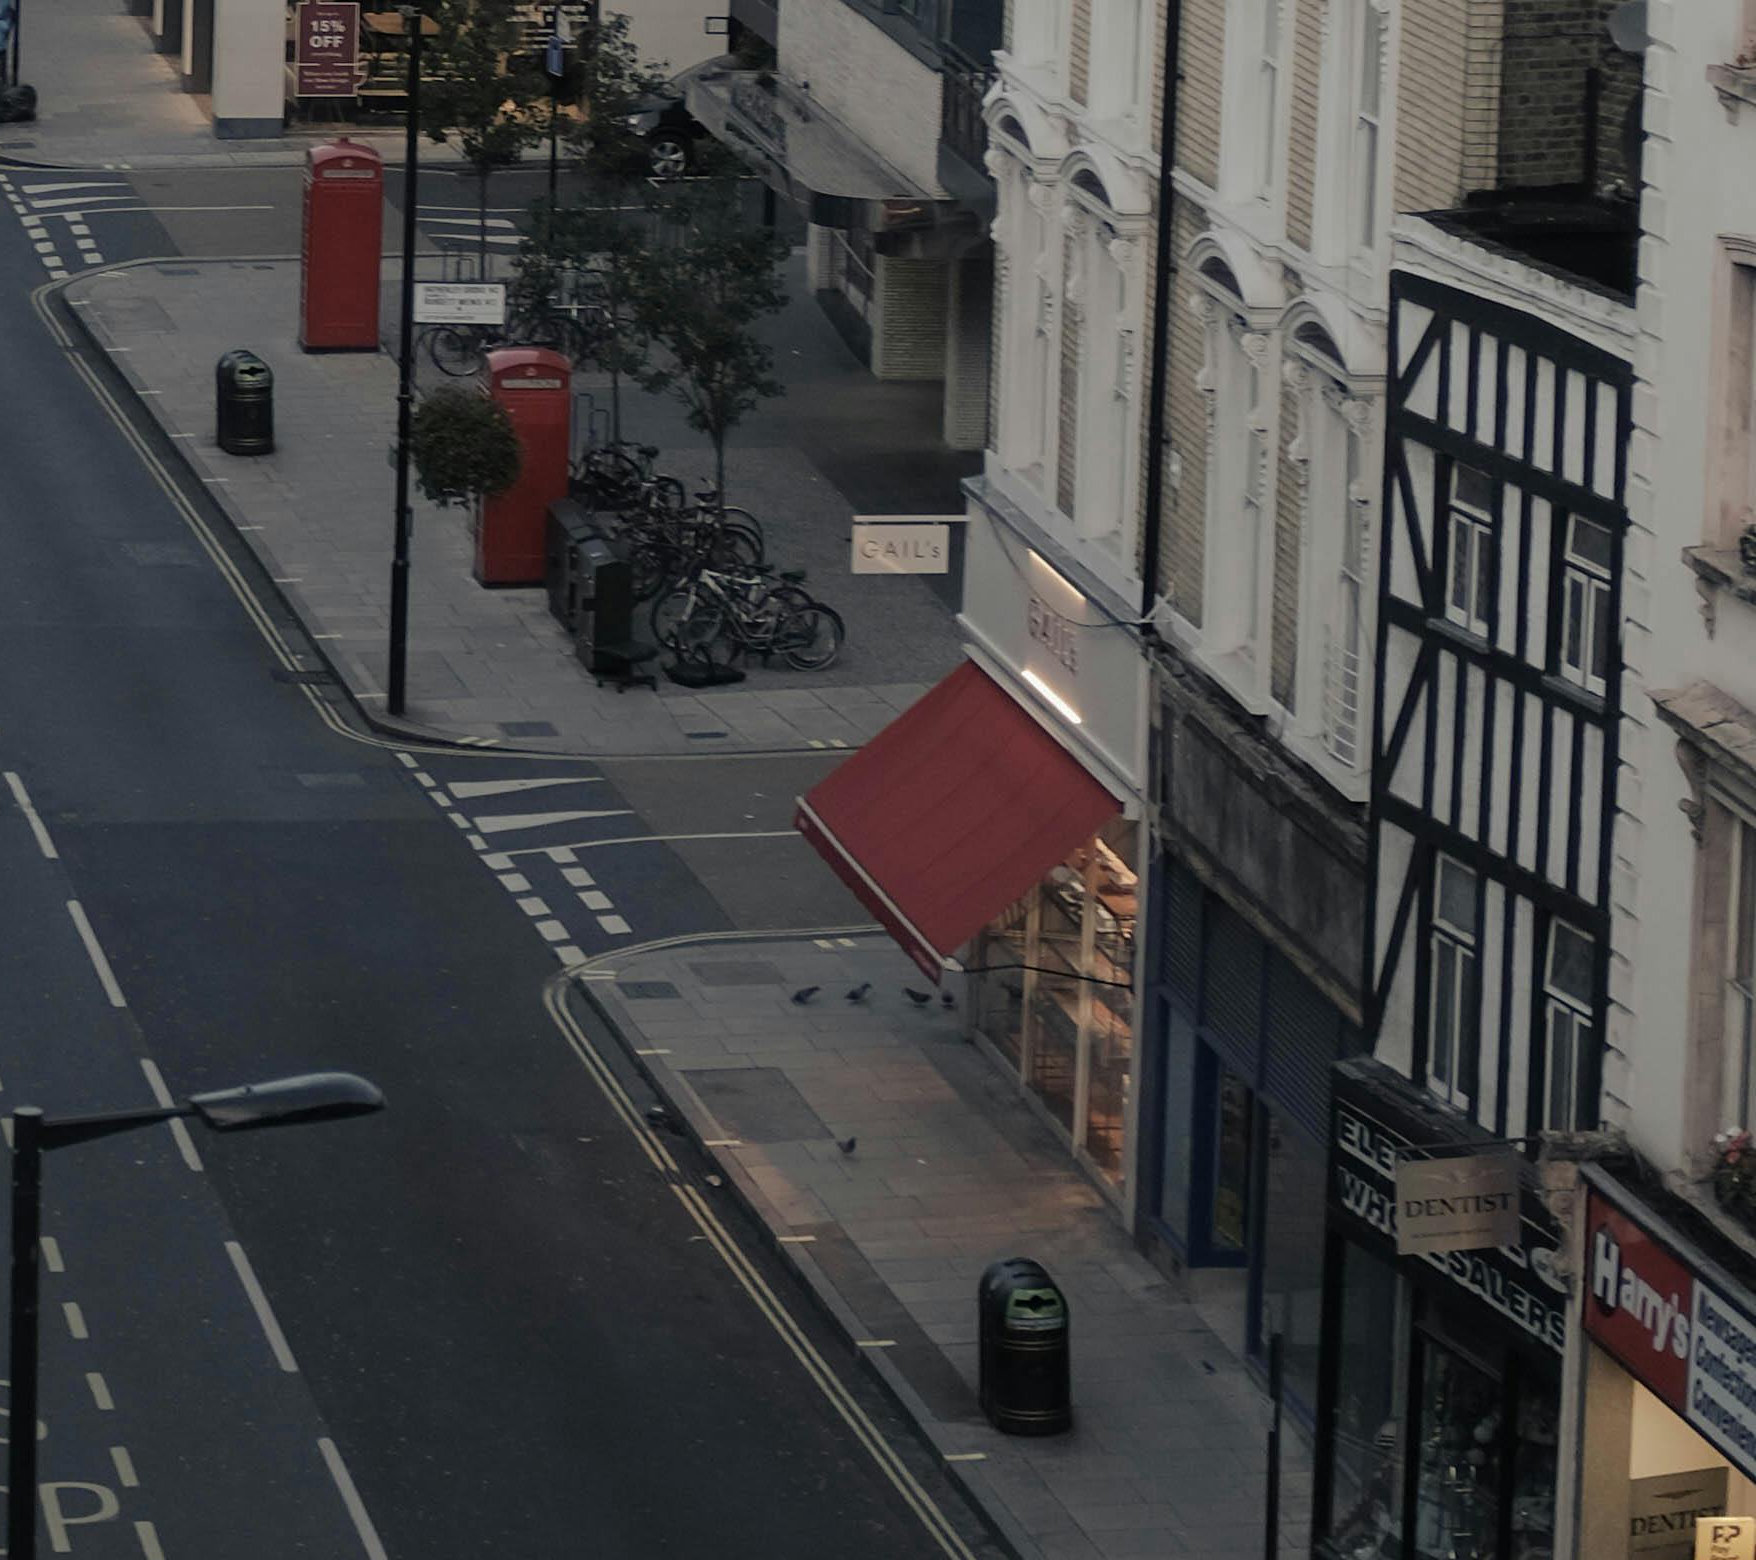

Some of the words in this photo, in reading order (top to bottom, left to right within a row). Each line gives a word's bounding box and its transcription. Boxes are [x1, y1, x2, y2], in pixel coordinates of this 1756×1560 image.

[309, 20, 347, 33] 15%
[308, 36, 345, 48] OFF
[1404, 1192, 1516, 1218] DENTIST
[1338, 1164, 1566, 1358] WHSALERS
[1594, 1231, 1690, 1360] Harry's
